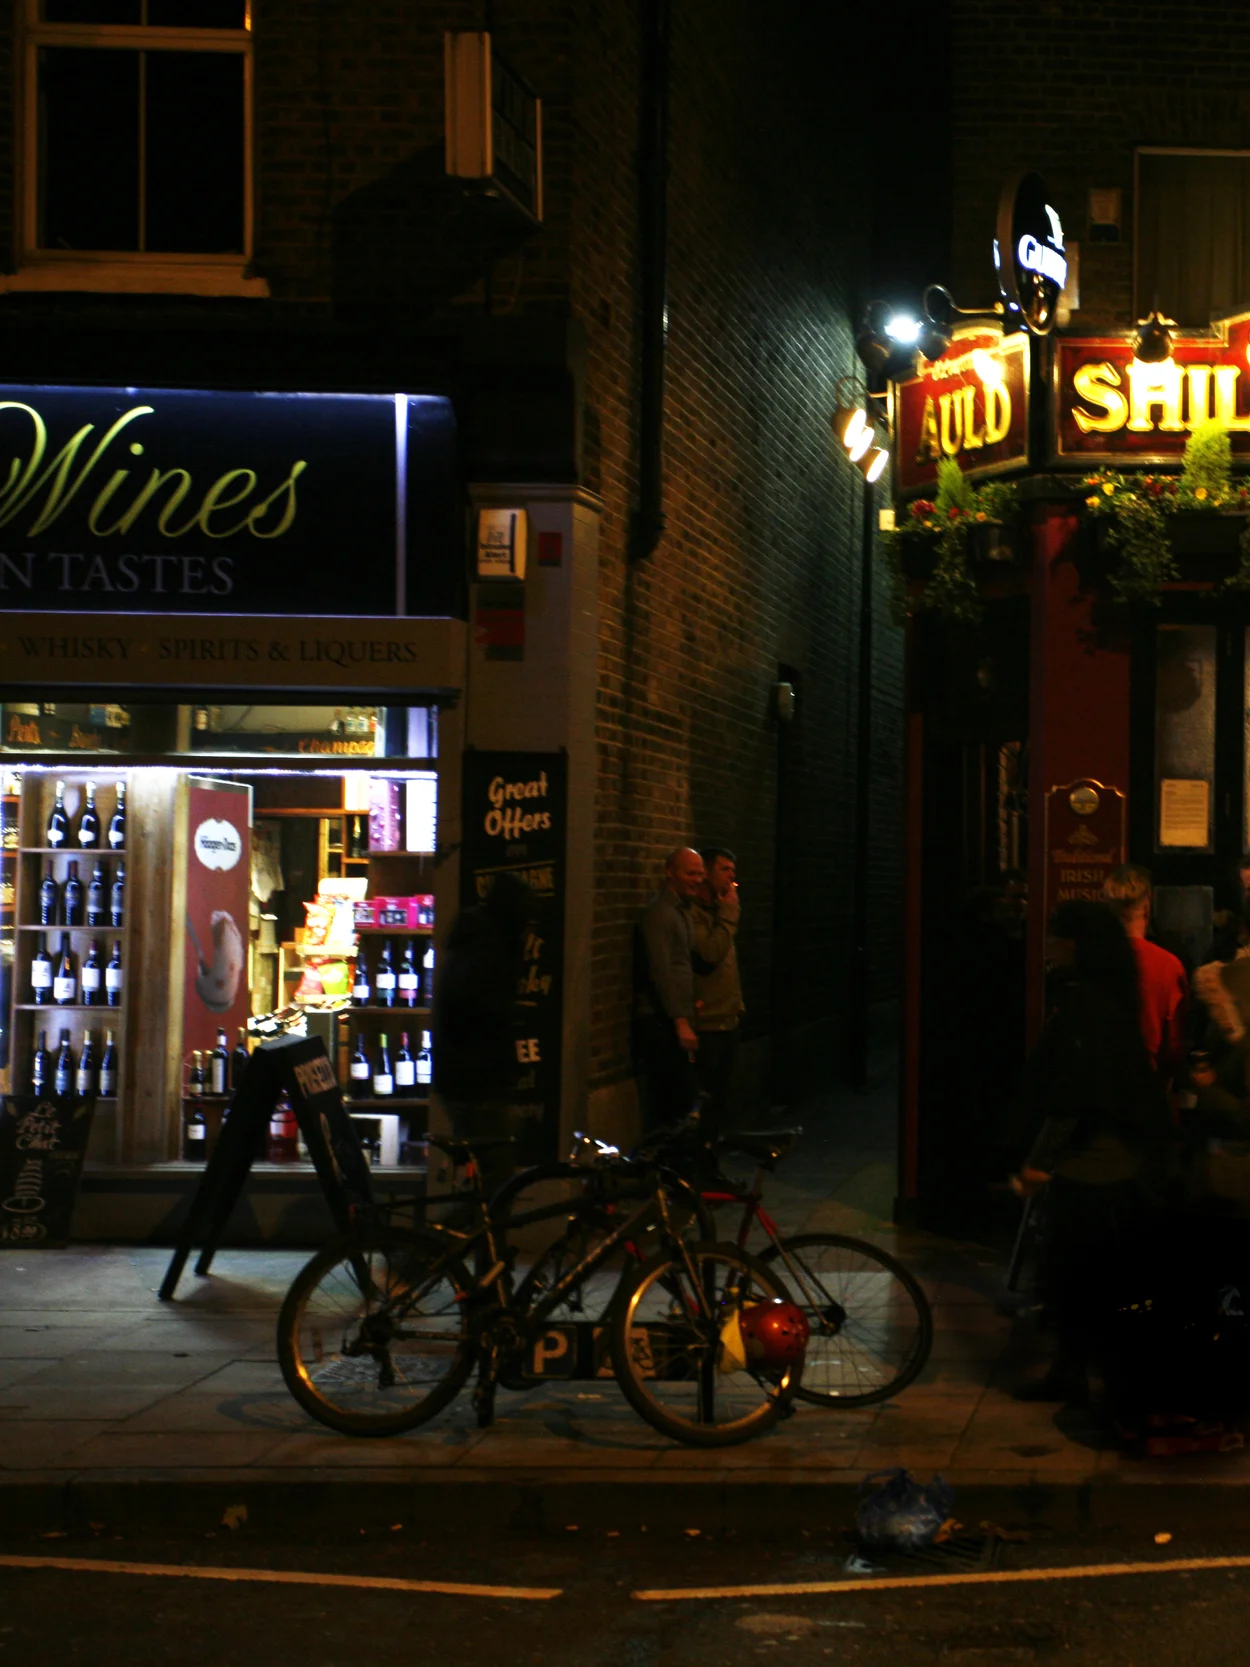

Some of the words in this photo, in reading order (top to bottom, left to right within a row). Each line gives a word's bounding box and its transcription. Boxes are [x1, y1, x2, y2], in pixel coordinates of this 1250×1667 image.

[915, 380, 1012, 463] AULD
[0, 400, 309, 540] Wines
[47, 553, 237, 596] TASTES
[17, 636, 133, 660] WHISKY
[158, 637, 261, 661] SPIRITS
[267, 640, 291, 661] &
[300, 638, 419, 668] LIQUERS
[487, 769, 549, 809] Great
[483, 805, 553, 841] Offers
[1060, 868, 1105, 884] IRISH
[532, 1329, 569, 1375] P
